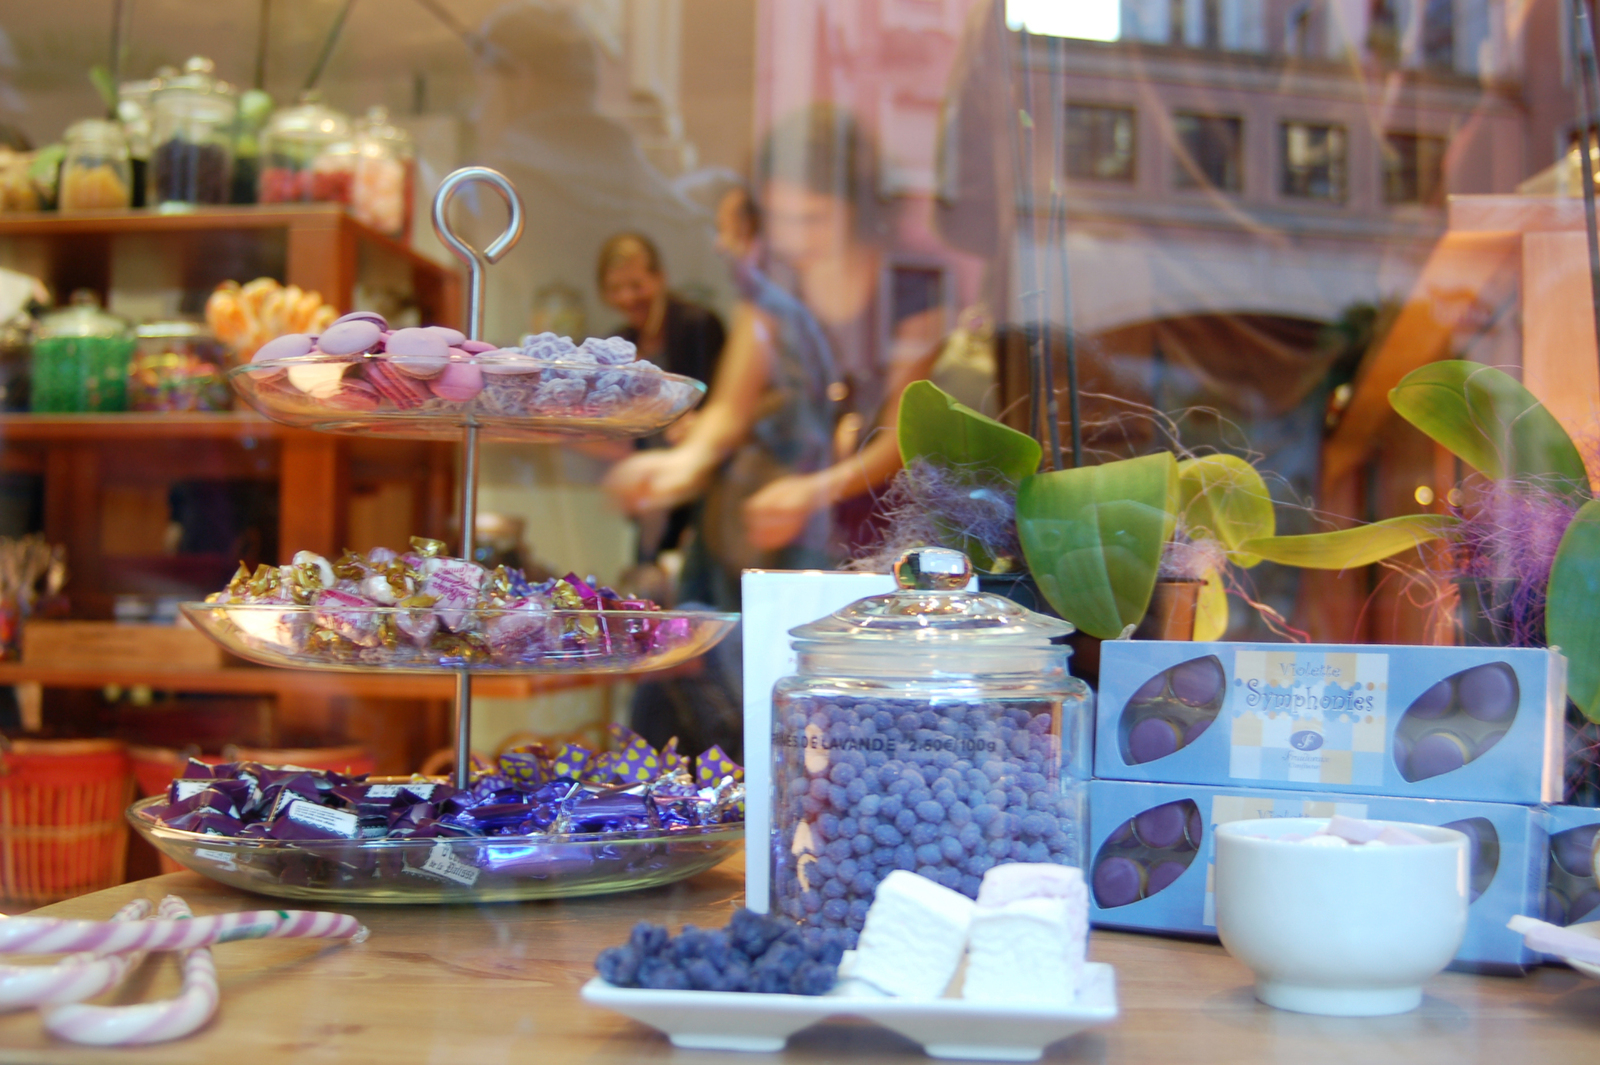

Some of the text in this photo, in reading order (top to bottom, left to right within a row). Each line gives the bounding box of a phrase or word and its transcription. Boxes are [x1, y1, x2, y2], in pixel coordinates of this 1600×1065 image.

[1279, 661, 1342, 677] Violette
[1246, 678, 1374, 713] Symphonies
[821, 736, 896, 751] LAVANDE
